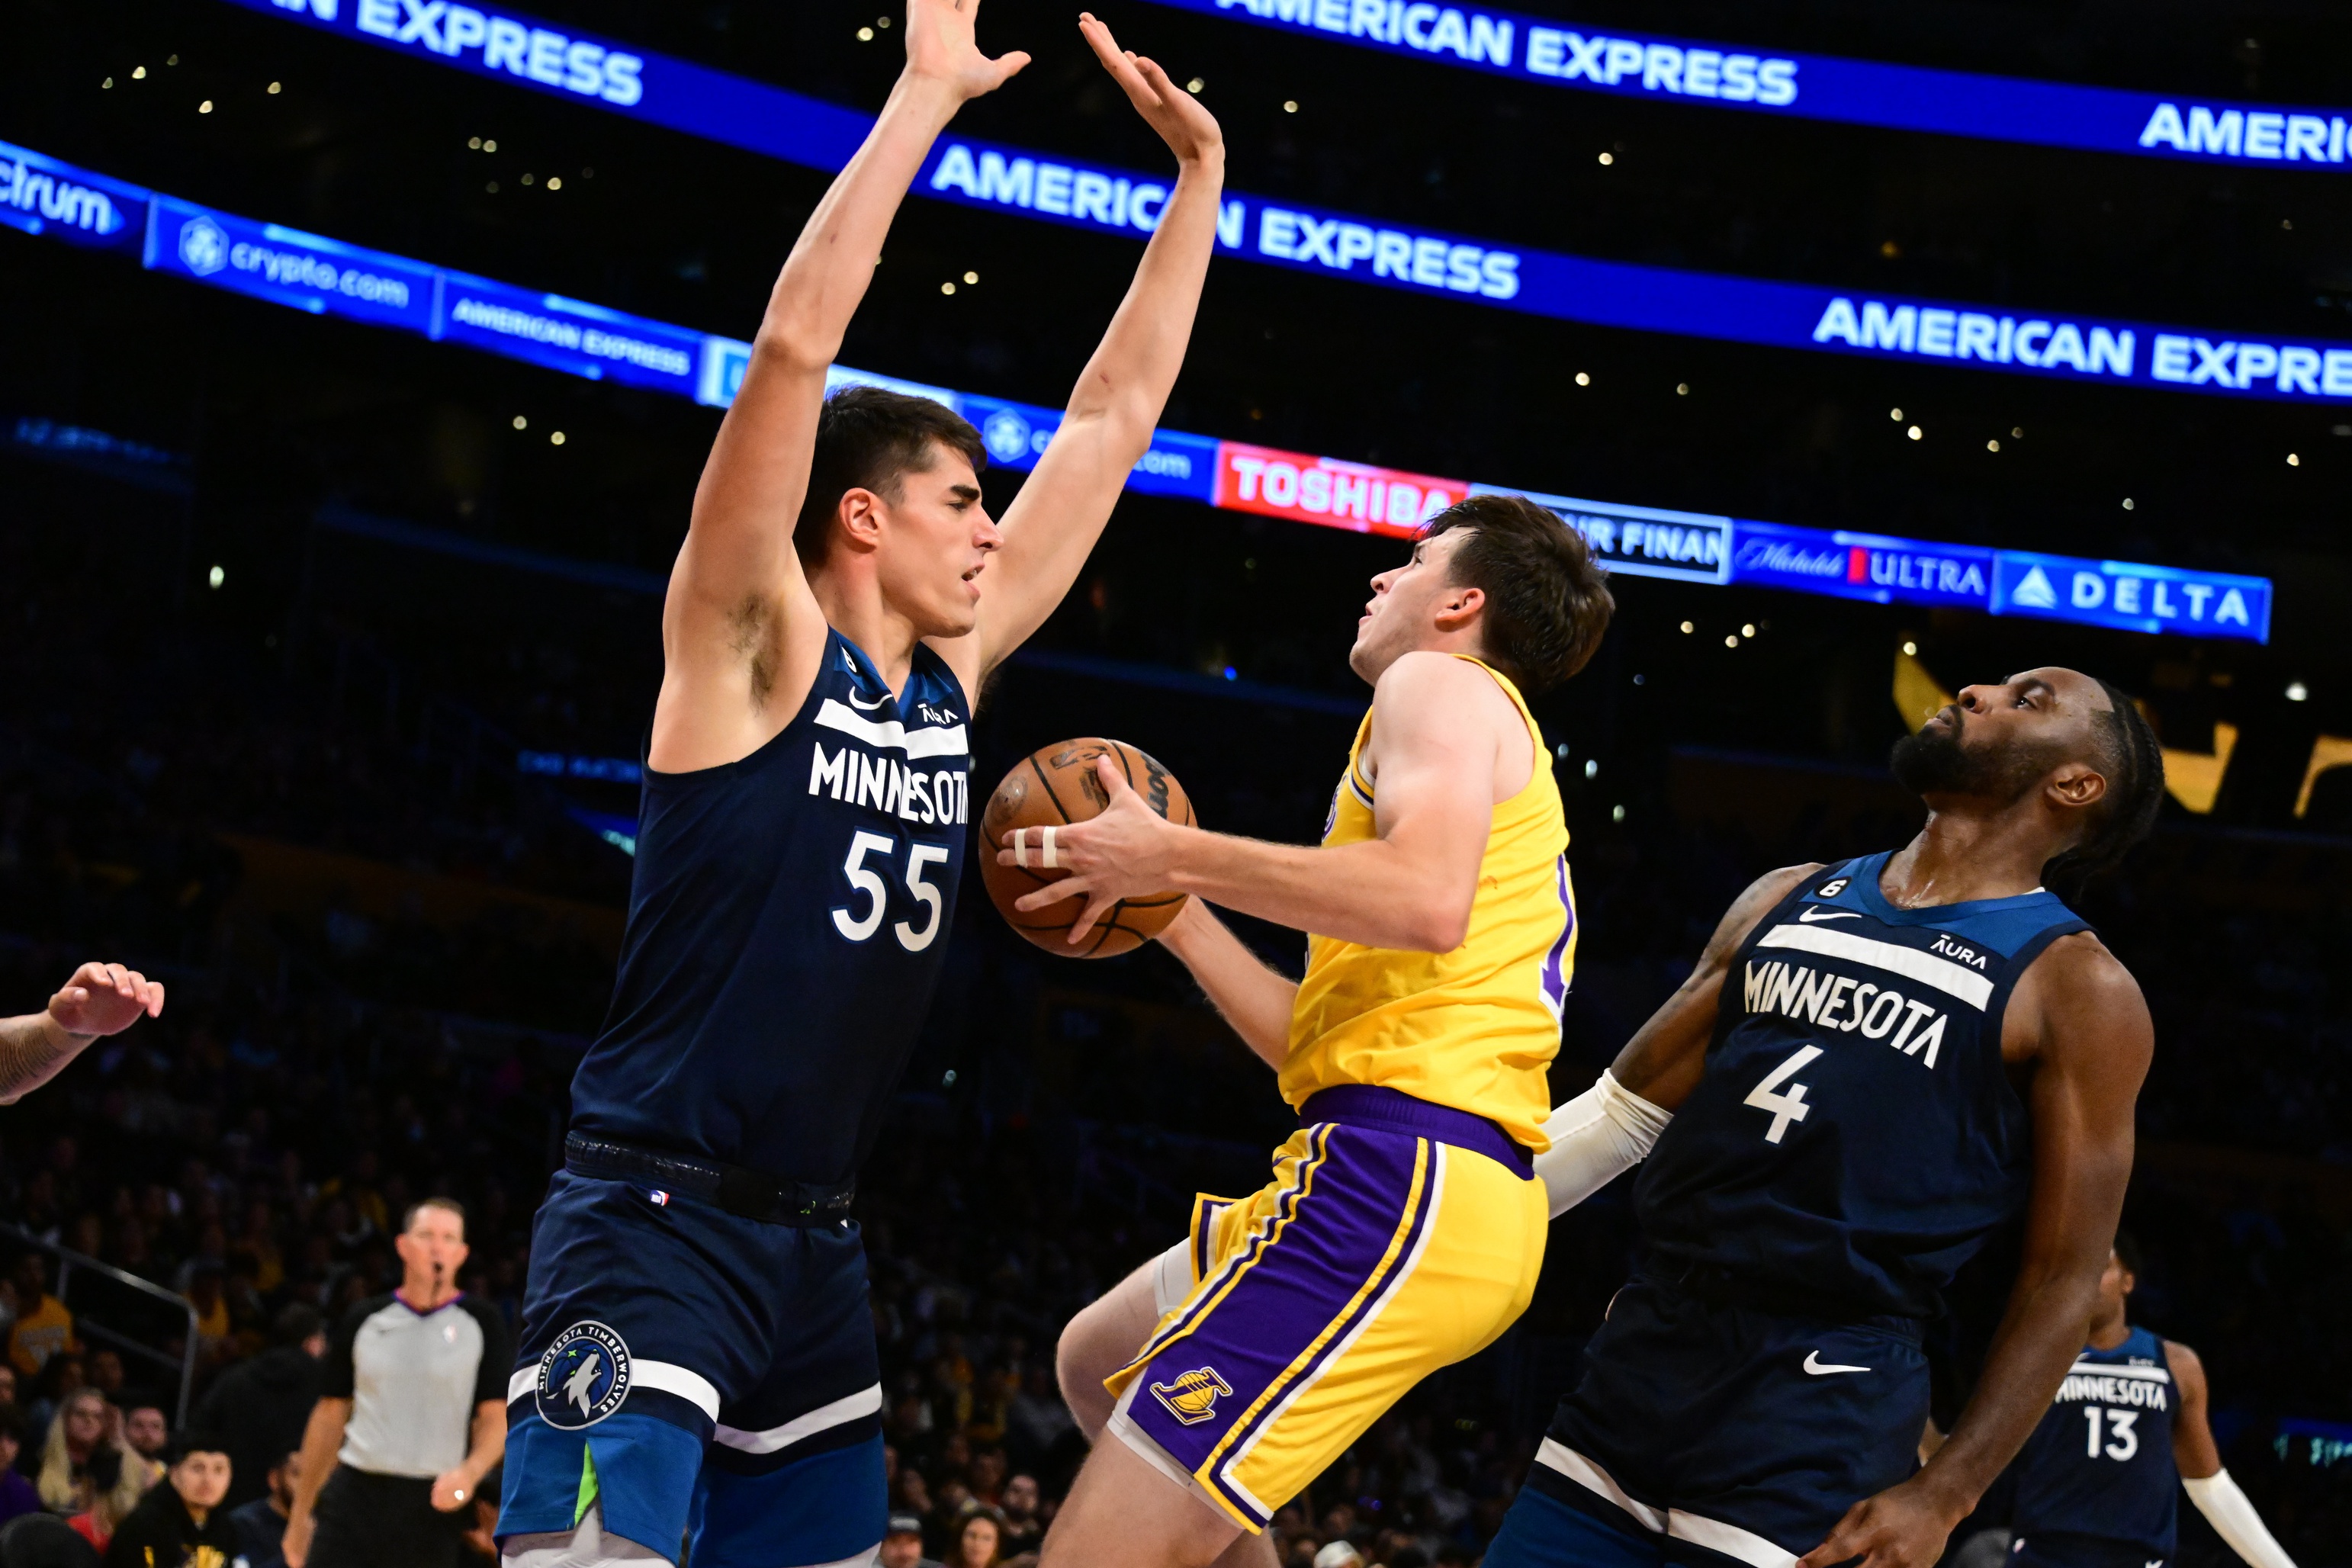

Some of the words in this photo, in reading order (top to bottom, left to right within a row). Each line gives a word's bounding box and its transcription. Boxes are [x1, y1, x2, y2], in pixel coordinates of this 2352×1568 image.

[356, 0, 643, 106] EXPRESS
[1525, 26, 1798, 107] EXPRESS
[2138, 102, 2352, 163] AMERI
[930, 145, 1246, 250] AMERICN
[1258, 208, 1520, 300] EXPRESS
[230, 242, 410, 309] crypto.com
[451, 297, 582, 350] AMERICAN
[582, 328, 689, 376] EXPRESS
[1813, 297, 2135, 377] AMERICAN
[1231, 455, 1450, 530] TOSHIBA
[1870, 551, 1986, 596] ULTRA
[2071, 570, 2250, 627] DELTA
[832, 830, 949, 952] 55
[1819, 879, 1847, 898] 6
[1744, 959, 1948, 1070] MINNESOTA
[1743, 1044, 1825, 1145] 4
[538, 1328, 583, 1390] MINNESOTA
[588, 1326, 628, 1412] TIMBERWOLVES
[2084, 1406, 2140, 1462] 13
